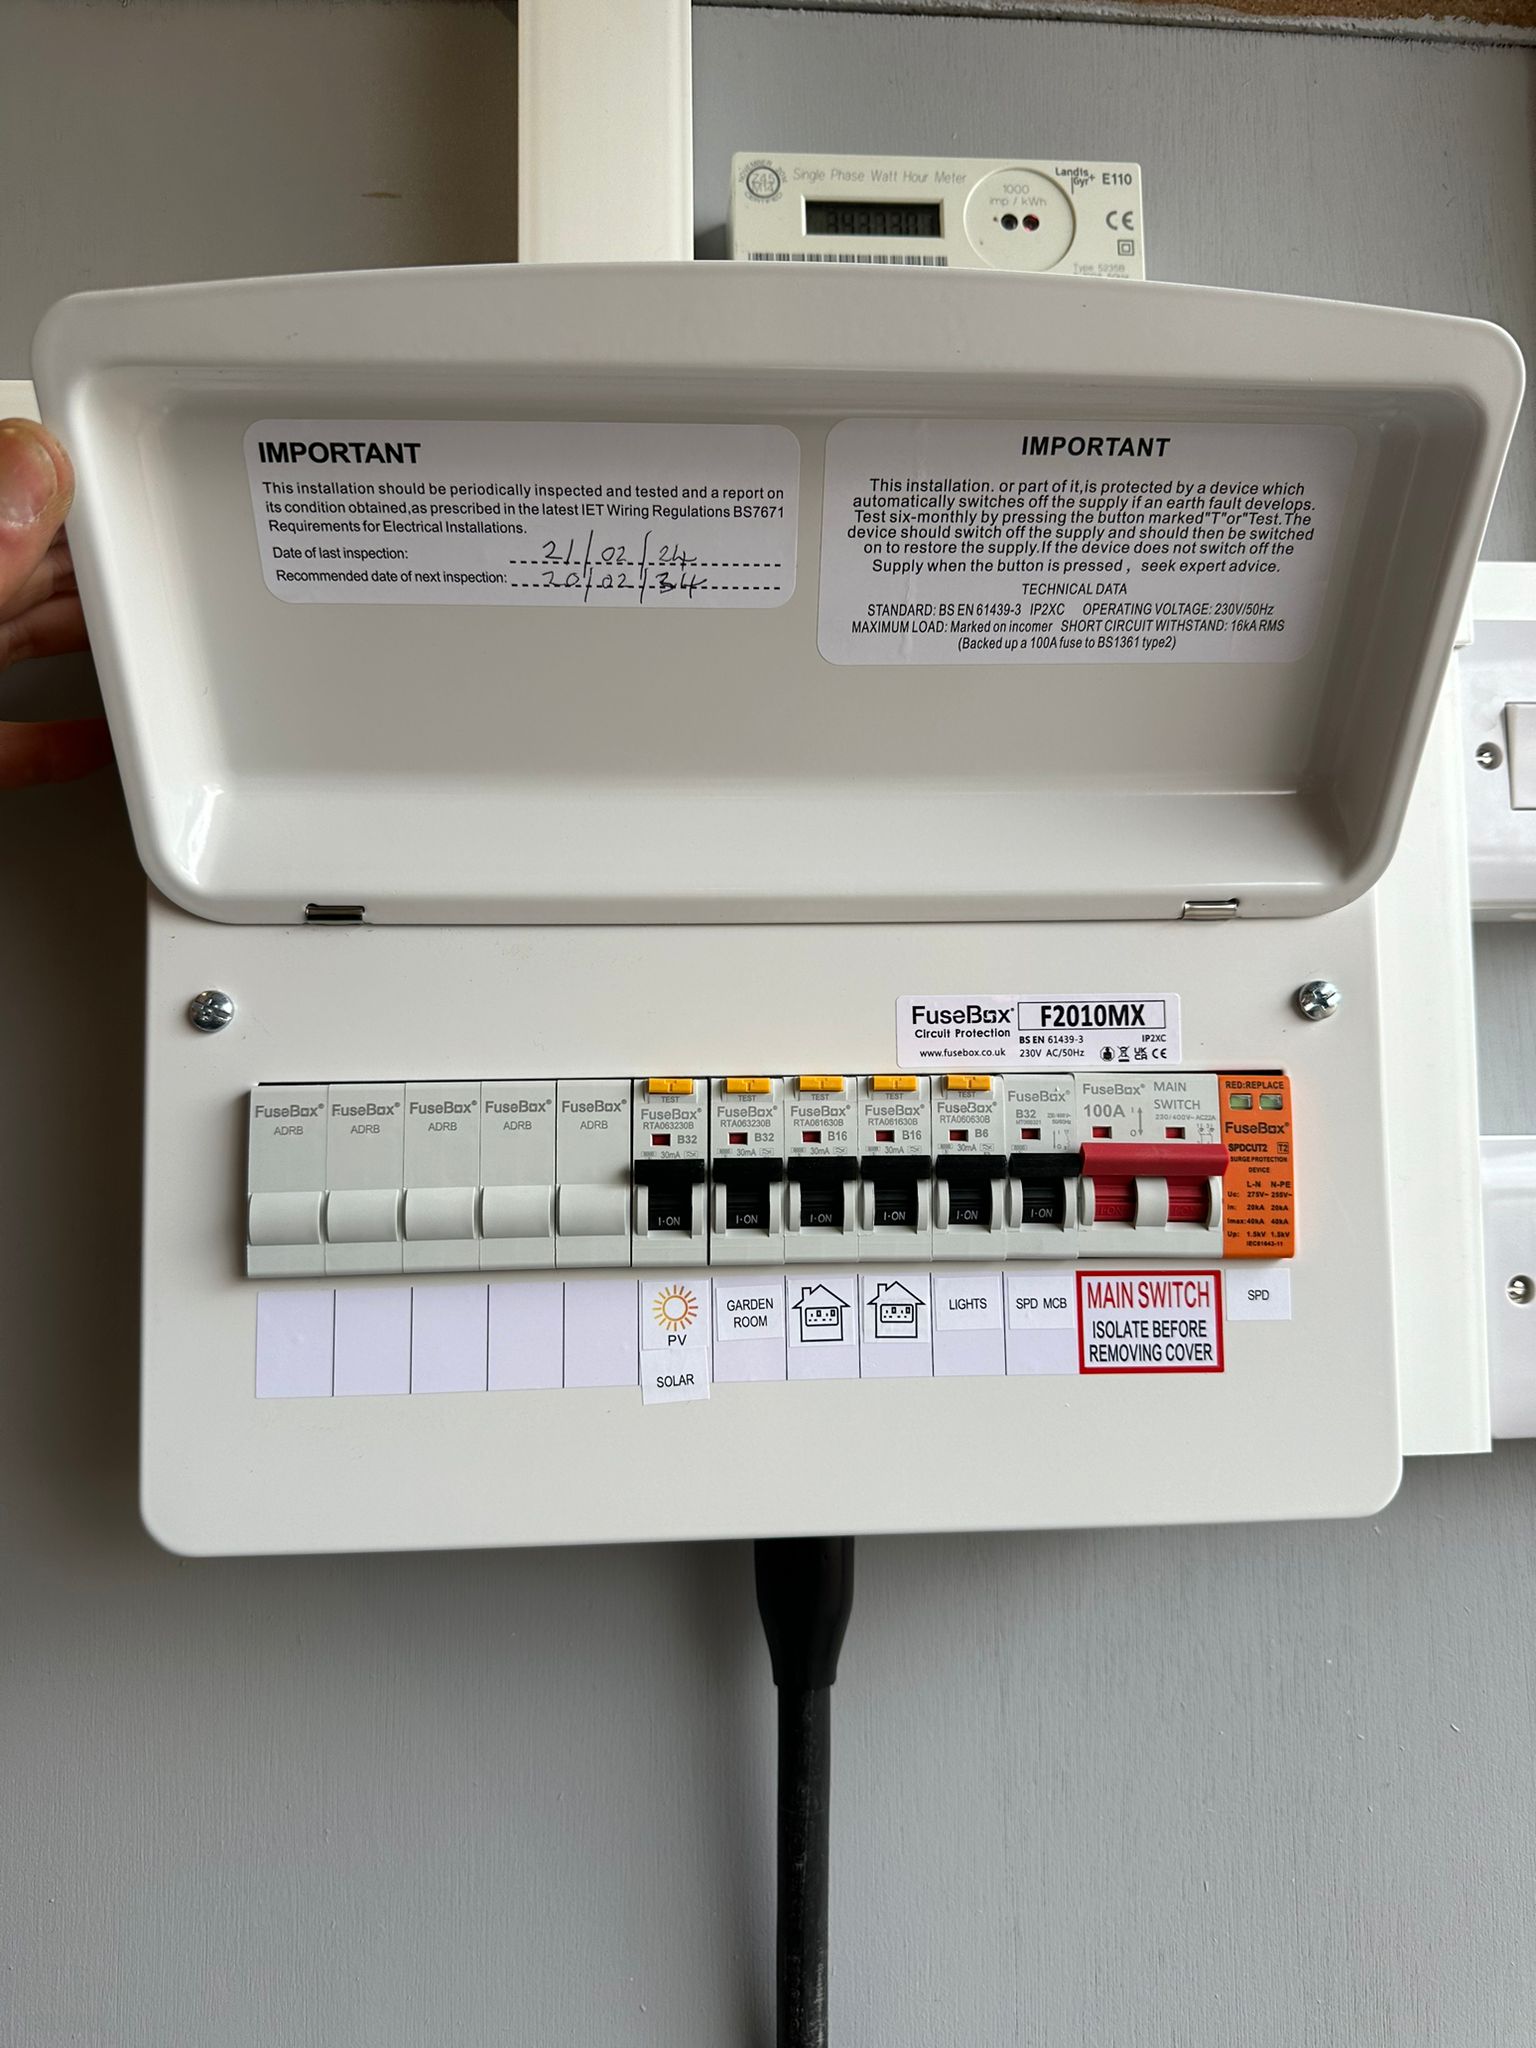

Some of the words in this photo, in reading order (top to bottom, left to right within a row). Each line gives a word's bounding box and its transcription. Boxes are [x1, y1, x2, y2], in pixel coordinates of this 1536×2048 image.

[793, 168, 825, 184] Single
[831, 168, 865, 182] Phase
[871, 170, 897, 182] Watt
[903, 171, 928, 183] Hour
[935, 171, 966, 184] Meter
[1055, 167, 1088, 177] Landis
[1102, 173, 1132, 185] E110
[1003, 184, 1030, 193] 1000
[990, 198, 1009, 207] imp
[1022, 197, 1047, 206] kWh
[1106, 211, 1134, 231] CE
[1074, 263, 1093, 273] Type
[1021, 436, 1171, 457] IMPORTANT
[258, 441, 421, 464] IMPORTANT
[272, 546, 302, 559] Date
[304, 546, 316, 559] of
[318, 547, 341, 559] last
[343, 547, 408, 561] inspection:
[276, 569, 368, 582] Recommended
[370, 570, 398, 582] date
[400, 570, 412, 582] of
[414, 571, 441, 582] next
[443, 571, 507, 585] inspection:
[1021, 582, 1093, 595] TECHNICAL
[1095, 582, 1127, 595] DATA
[867, 603, 936, 616] STANDARD:
[938, 603, 955, 616] BS
[957, 603, 974, 616] EN
[976, 603, 1021, 616] 61439-3
[1029, 602, 1065, 615] IP2XC
[1082, 602, 1152, 615] OPERATING
[1155, 602, 1212, 615] VOLTAGE:
[1213, 602, 1274, 615] 230V/50Hz
[851, 620, 909, 633] MAXIMUM
[911, 620, 948, 633] LOAD:
[950, 620, 991, 633] Marked
[992, 622, 1007, 632] on
[1008, 620, 1053, 632] incomer
[1060, 619, 1103, 632] SHORT
[1104, 619, 1154, 632] CIRCUIT
[1155, 619, 1228, 632] WITHSTAND:
[1231, 619, 1256, 631] 16kA
[1258, 619, 1285, 631] RMS
[957, 636, 1003, 652] (Backed
[1004, 639, 1018, 651] up
[1020, 639, 1027, 649] a
[1030, 637, 1057, 649] 100A
[1059, 637, 1083, 649] fuse
[1084, 637, 1095, 649] to
[1097, 637, 1139, 649] BS1361
[1142, 635, 1176, 651] type2)
[1041, 1004, 1145, 1028] F2010MX
[915, 1029, 950, 1038] Circuit
[955, 1028, 1010, 1037] Protection
[1142, 1034, 1166, 1042] IP2XC
[1020, 1036, 1030, 1044] BS
[1048, 1035, 1083, 1043] 61439-3
[920, 1048, 1005, 1057] www.fusebox.co.uk
[1020, 1049, 1041, 1057] 230V
[1046, 1049, 1084, 1057] AC/50Hz
[1152, 1048, 1167, 1059] CE
[1154, 1082, 1186, 1091] MAIN
[1225, 1081, 1284, 1089] RED:REPLACE
[660, 1095, 681, 1103] TEST
[737, 1093, 757, 1101] TEST
[811, 1092, 831, 1100] TEST
[885, 1092, 905, 1100] TEST
[957, 1090, 977, 1098] TEST
[1154, 1099, 1200, 1110] SWITCH
[1016, 1109, 1036, 1118] B32
[1084, 1104, 1125, 1117] 100A
[351, 1124, 380, 1134] ADRB
[428, 1122, 457, 1131] ADRB
[503, 1121, 532, 1130] ADRB
[580, 1120, 608, 1129] ADRB
[274, 1126, 303, 1135] ADRB
[902, 1130, 921, 1140] B16
[975, 1129, 988, 1137] B6
[678, 1135, 697, 1144] B32
[755, 1133, 774, 1142] B32
[828, 1131, 847, 1141] B16
[737, 1148, 756, 1156] 30mA
[810, 1147, 830, 1155] 30mA
[884, 1146, 905, 1155] 30mA
[957, 1144, 977, 1152] 30mA
[1228, 1143, 1268, 1152] SPDCUT2
[1278, 1143, 1288, 1152] T2
[660, 1151, 680, 1159] 30mA
[1088, 1282, 1133, 1308] MAIN
[1138, 1281, 1209, 1308] SWITCH
[1248, 1290, 1269, 1300] SPD
[727, 1298, 773, 1311] GARDEN
[949, 1298, 987, 1310] LIGHTS
[1016, 1298, 1038, 1309] SPD
[1044, 1298, 1067, 1309] MCB
[734, 1315, 767, 1328] ROOM
[1093, 1321, 1149, 1338] ISOLATE
[1153, 1320, 1207, 1338] BEFORE
[668, 1335, 687, 1346] PV
[1090, 1344, 1161, 1362] REMOVING
[1166, 1343, 1213, 1361] COVER
[657, 1374, 694, 1388] SOLAR
